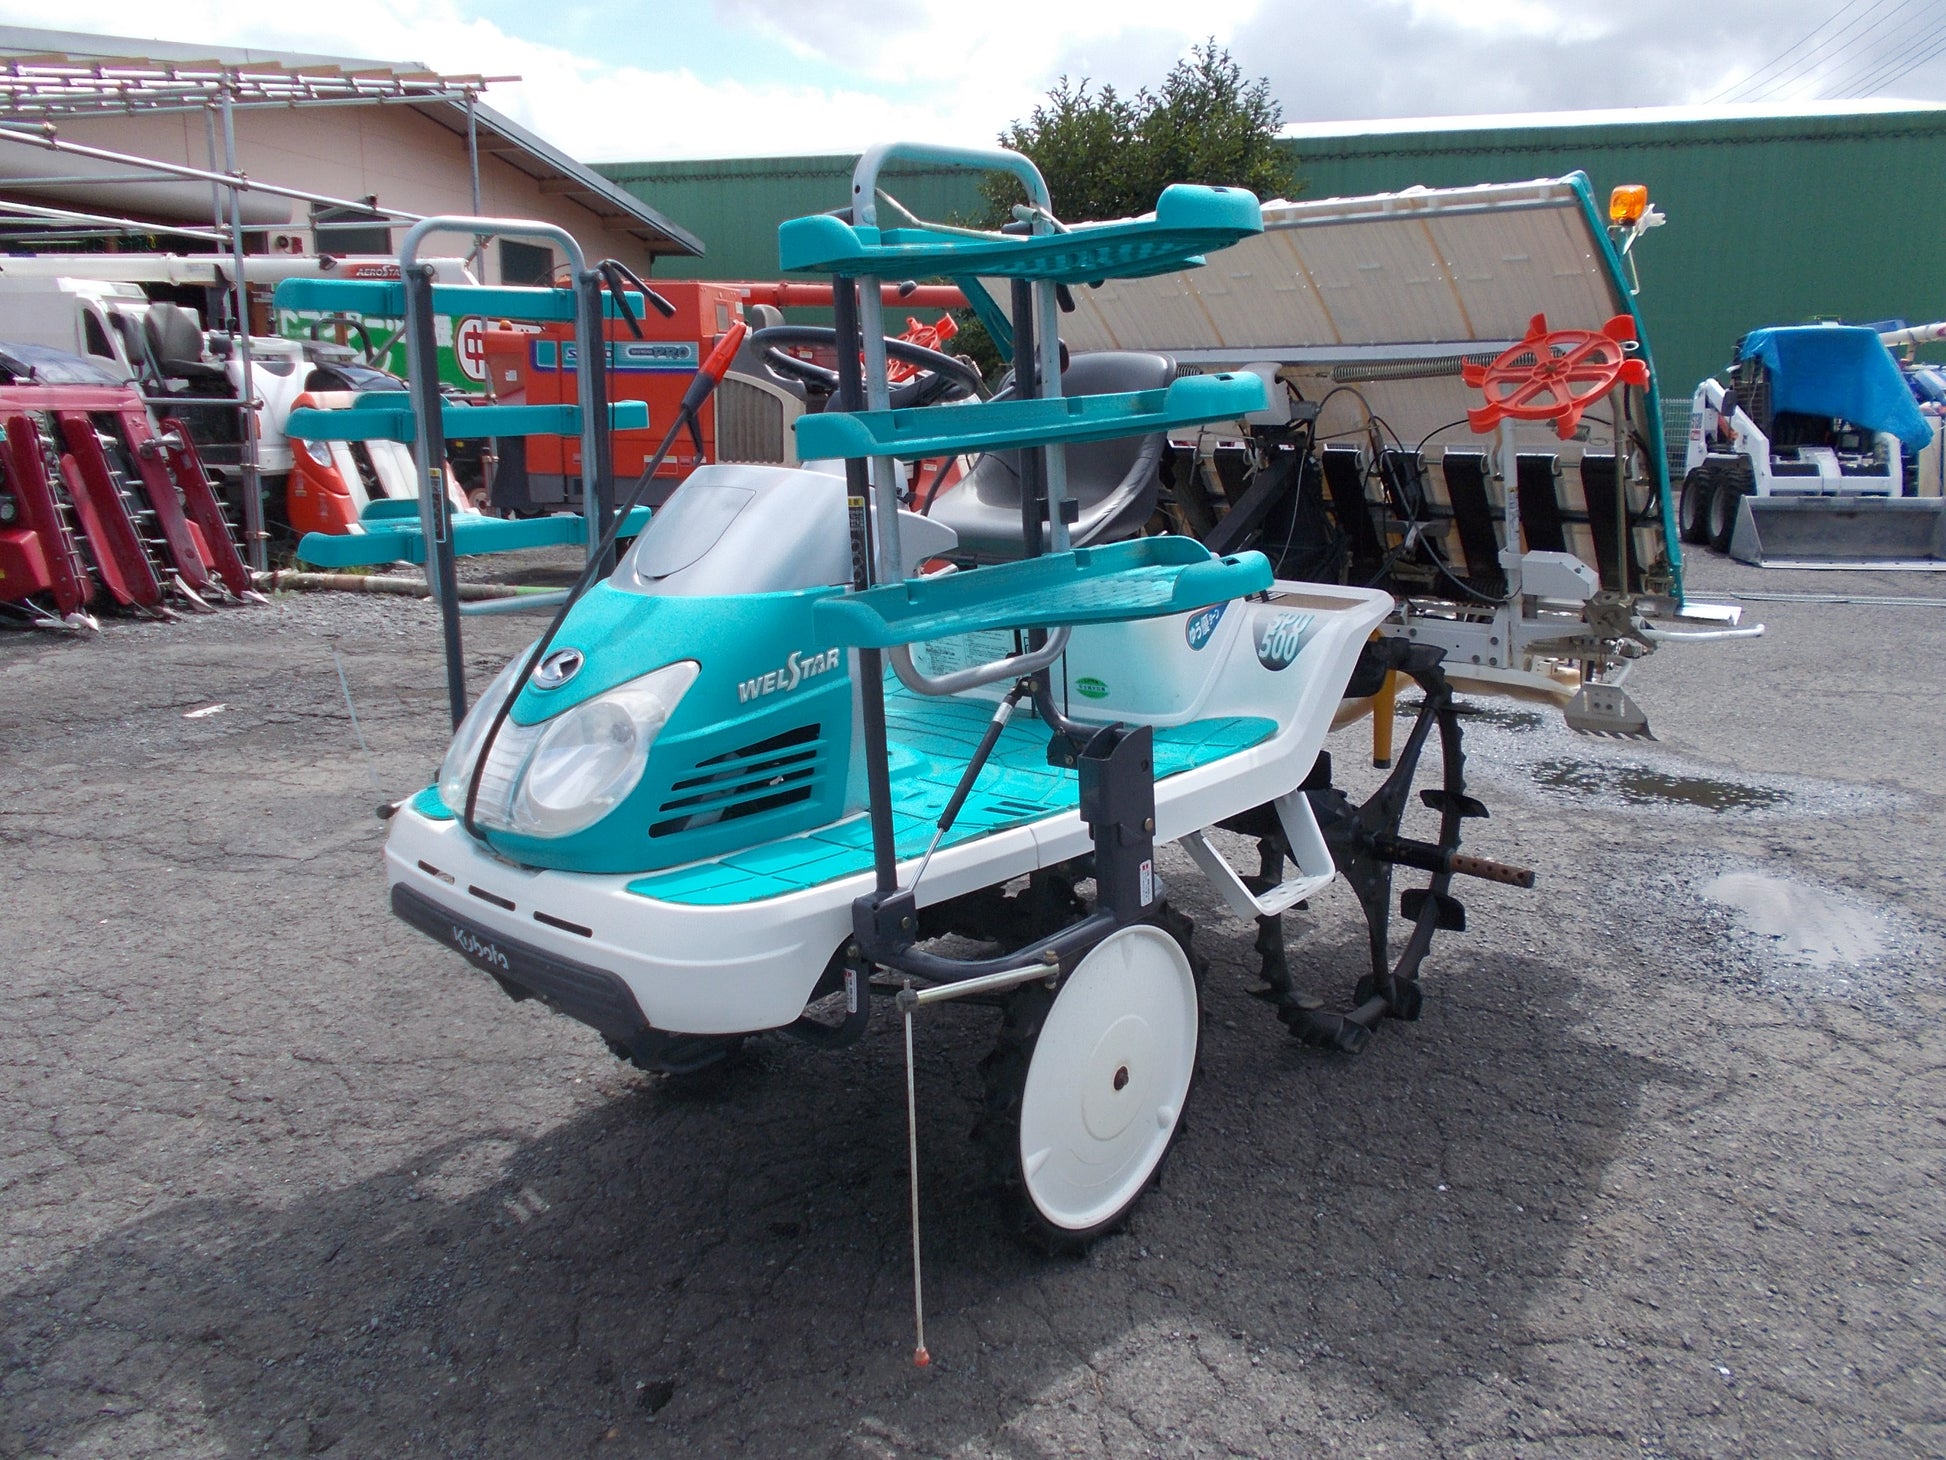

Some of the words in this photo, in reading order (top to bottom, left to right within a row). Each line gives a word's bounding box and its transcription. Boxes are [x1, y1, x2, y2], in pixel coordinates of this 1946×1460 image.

[356, 265, 402, 277] AEROSTA
[1258, 627, 1300, 662] 500
[452, 925, 509, 970] Kubota
